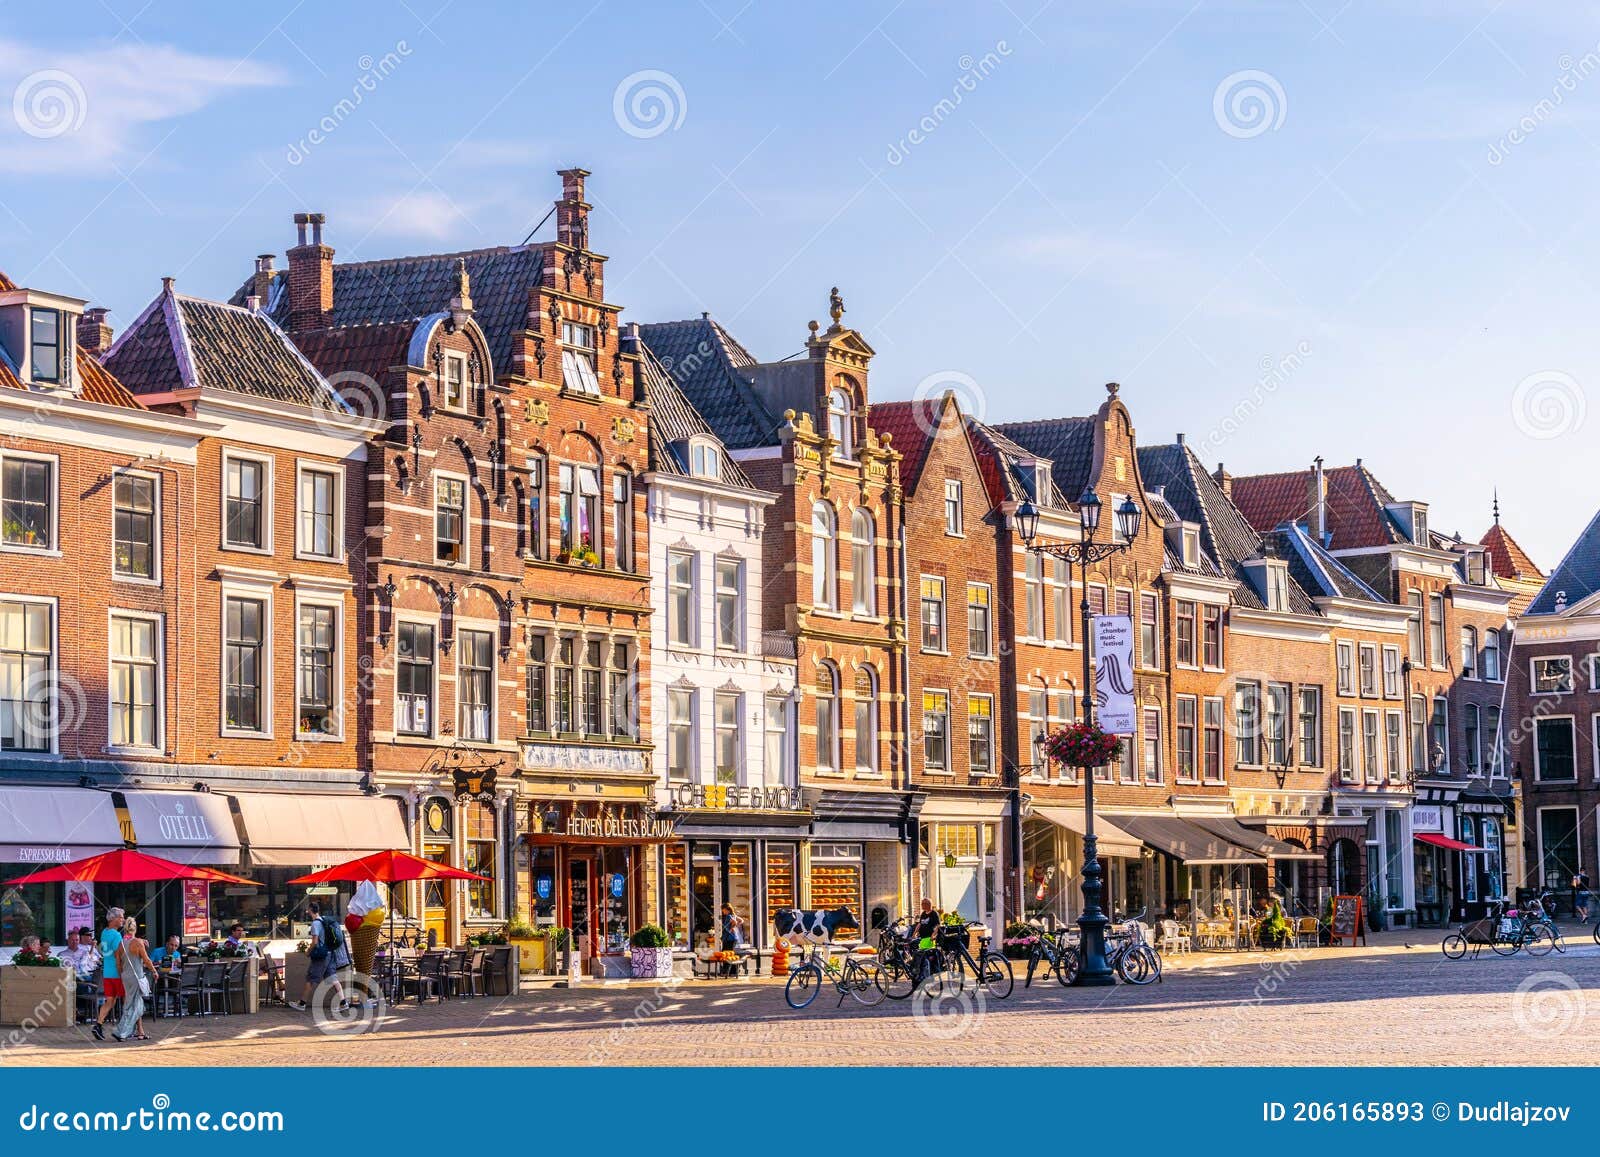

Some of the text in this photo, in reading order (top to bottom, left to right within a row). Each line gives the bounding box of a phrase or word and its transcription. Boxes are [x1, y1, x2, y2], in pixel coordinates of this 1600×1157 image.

[567, 817, 602, 836] HEINEN
[641, 819, 674, 838] BLAUW
[20, 848, 71, 861] ESPRESSO BAR
